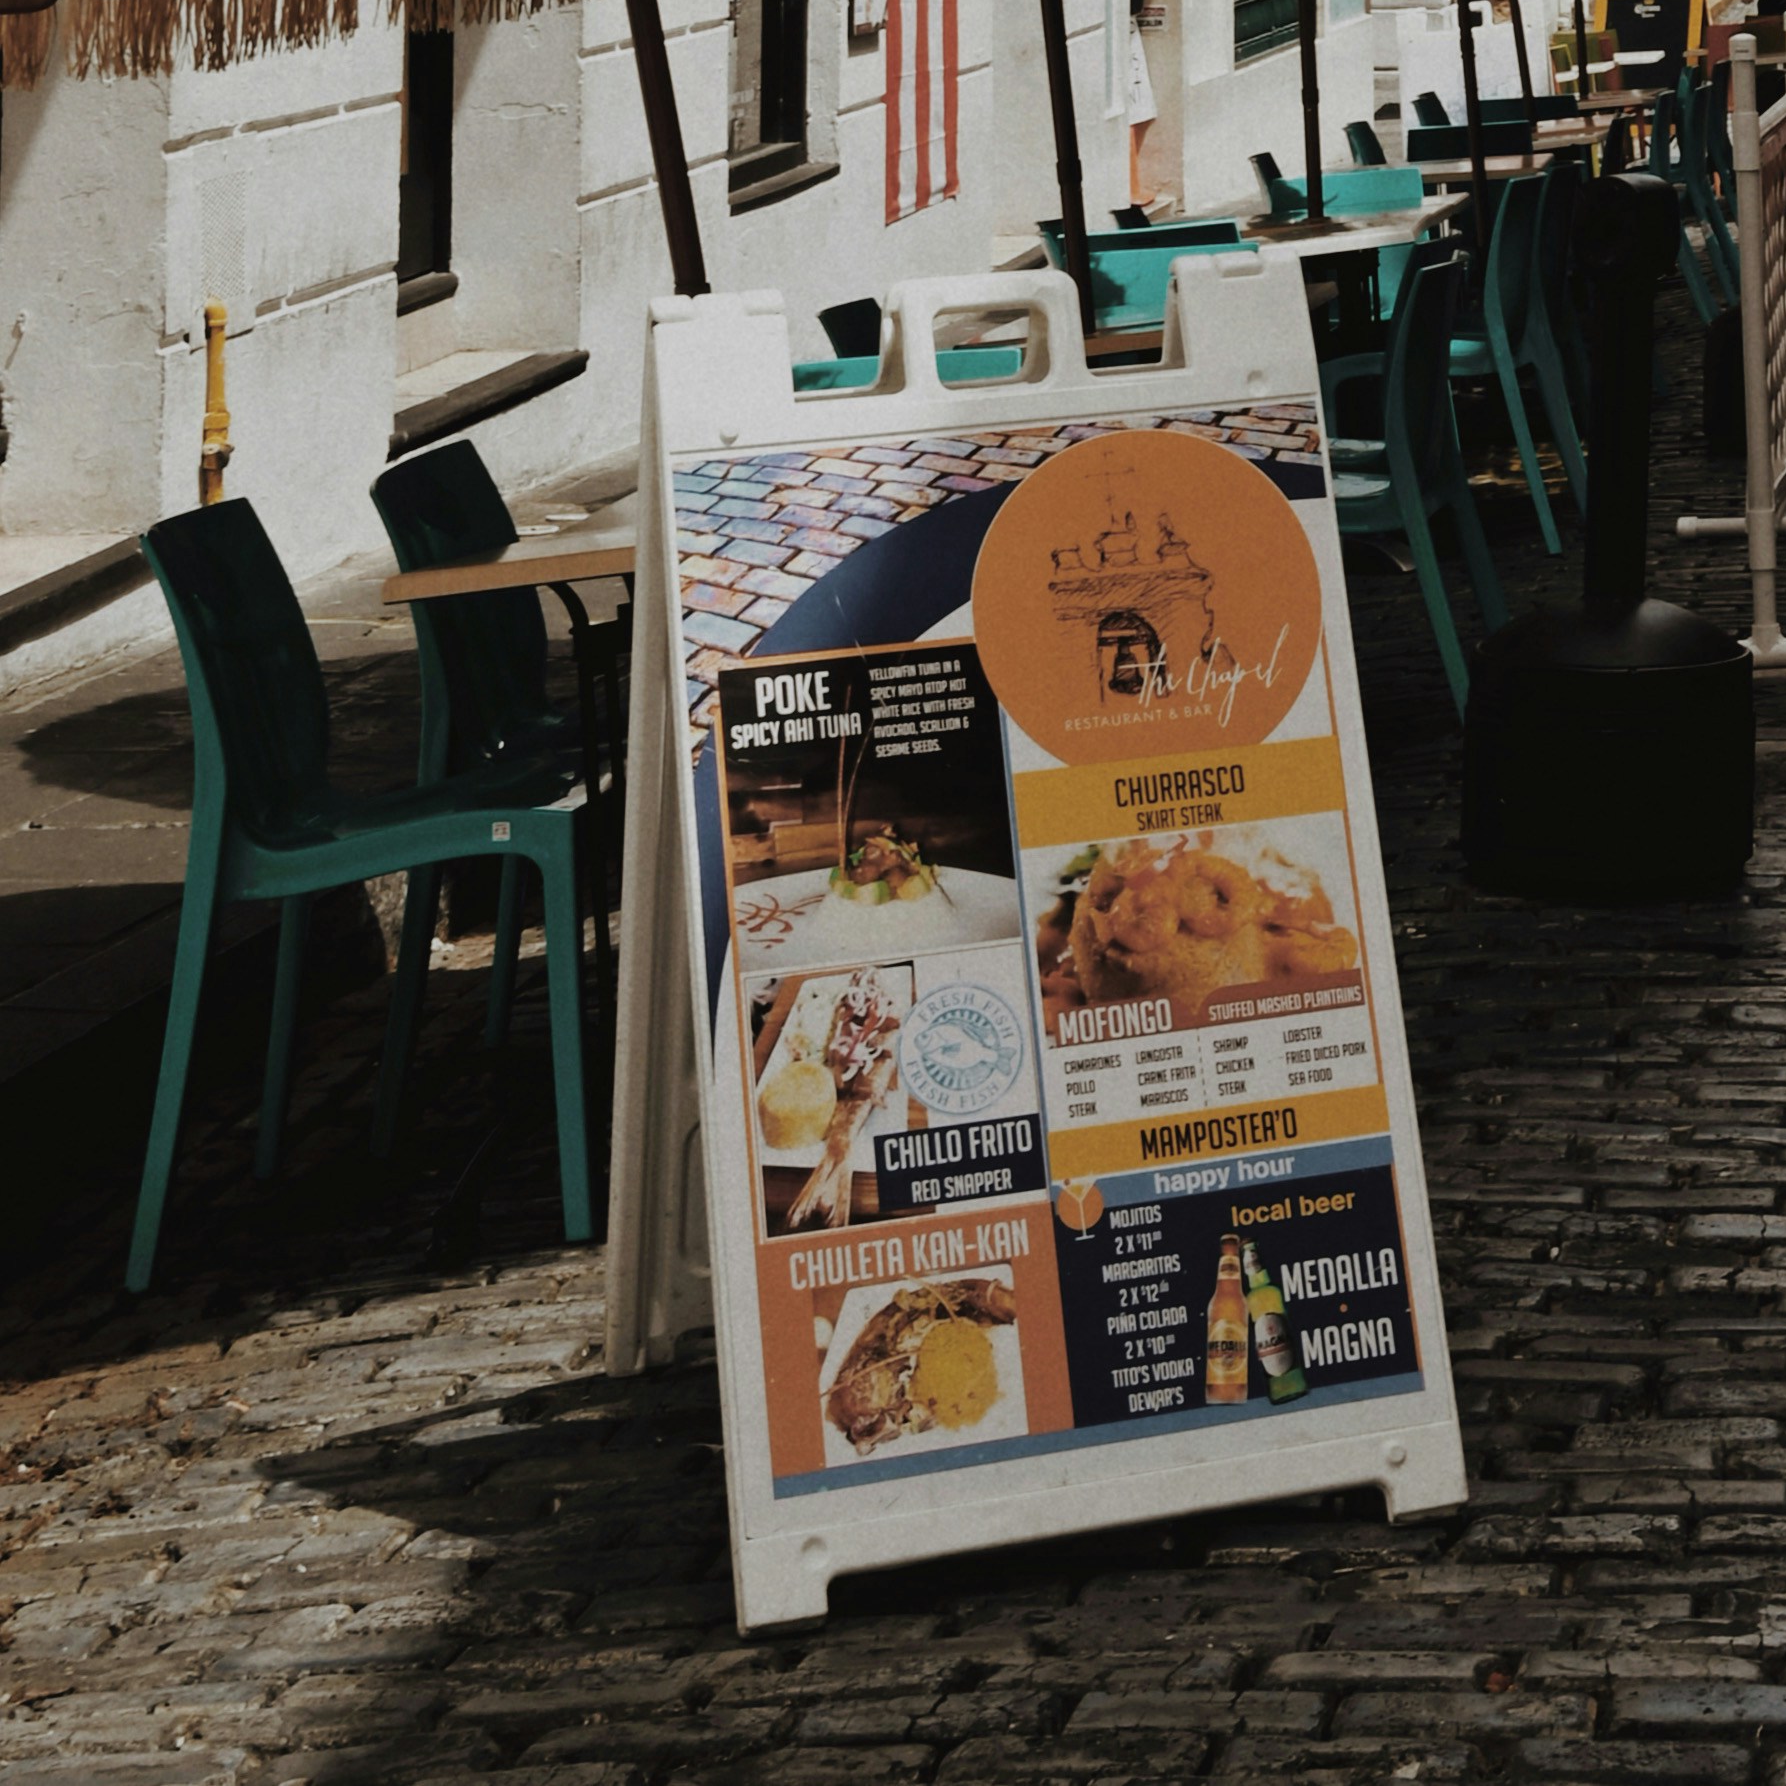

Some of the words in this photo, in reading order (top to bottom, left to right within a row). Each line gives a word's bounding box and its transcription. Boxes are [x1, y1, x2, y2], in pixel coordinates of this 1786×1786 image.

[869, 664, 917, 681] YELLOWFIN
[917, 661, 941, 676] TUNA
[953, 659, 961, 672] A
[1187, 623, 1290, 728] Chapel
[755, 671, 831, 718] POKE
[870, 685, 896, 701] SPICY
[898, 682, 923, 697] MAYO
[924, 680, 948, 694] ATOP
[949, 677, 967, 692] HOT
[872, 704, 900, 720] WHITE
[901, 702, 921, 716] RICE
[922, 699, 946, 713] WITH
[947, 696, 975, 711] FRESH
[1064, 709, 1163, 732] RESTAURANT
[1168, 707, 1179, 721] &
[1184, 703, 1213, 719] BAR
[730, 721, 780, 750] SPICY
[784, 717, 814, 743] AHI
[817, 712, 862, 740] TUNA
[875, 741, 910, 758] SESAME
[1114, 764, 1246, 808] CHURRASCO
[1136, 806, 1177, 831] SKIRT
[1180, 802, 1224, 827] STEAK
[918, 992, 975, 1022] FRESH
[983, 1000, 1014, 1040] FISH
[1208, 1001, 1255, 1022] STUFFED
[1256, 993, 1302, 1015] MASHED
[1303, 985, 1363, 1008] PLANTAINS
[1058, 998, 1173, 1046] MOFONGO
[1213, 1035, 1249, 1054] SHRIMP
[1283, 1026, 1323, 1044] LOBSTER
[1064, 1054, 1122, 1075] CAMARONES
[1135, 1045, 1183, 1065] LANGOSTA
[1215, 1056, 1255, 1075] CHICKEN
[1285, 1049, 1312, 1065] FRIED
[1313, 1045, 1340, 1061] DICED
[1342, 1041, 1368, 1057] PORK
[906, 1060, 950, 1107] FRESH
[960, 1083, 999, 1108] FISH
[1066, 1079, 1096, 1096] POLLO
[1138, 1068, 1169, 1086] CARNE
[1170, 1065, 1196, 1081] FRITA
[1218, 1080, 1247, 1097] STEAK
[1287, 1072, 1306, 1087] SEA
[1308, 1067, 1333, 1084] FOOD
[1068, 1101, 1098, 1118] STEAK
[1140, 1088, 1189, 1107] MARISCOS
[883, 1129, 963, 1171] CHILLO
[968, 1119, 1033, 1160] FRITO
[1140, 1108, 1298, 1161] MAMPOSTEA'O
[911, 1178, 941, 1203] RED
[944, 1168, 1012, 1198] SNAPPER
[1154, 1165, 1230, 1195] happy
[1236, 1156, 1295, 1182] hour
[1109, 1205, 1162, 1229] MOJITOS
[1231, 1197, 1292, 1227] local
[1298, 1191, 1356, 1217] beer
[788, 1237, 905, 1291] CHULETA
[912, 1218, 1030, 1272] KAN-KAN
[1114, 1236, 1124, 1255] 2
[1125, 1234, 1135, 1253] X
[1102, 1254, 1181, 1283] MARGARITAS
[1280, 1247, 1399, 1303] MEDALLA
[1119, 1288, 1128, 1307] 2
[1130, 1286, 1140, 1305] X
[1106, 1312, 1137, 1336] PIÑA
[1139, 1305, 1188, 1331] COLADA
[1124, 1340, 1134, 1360] 2
[1136, 1339, 1145, 1358] X
[1301, 1317, 1396, 1369] MAGNA
[1111, 1365, 1150, 1388] TITO'S
[1151, 1357, 1195, 1381] VODKA
[1128, 1386, 1185, 1413] DEWAR'S
